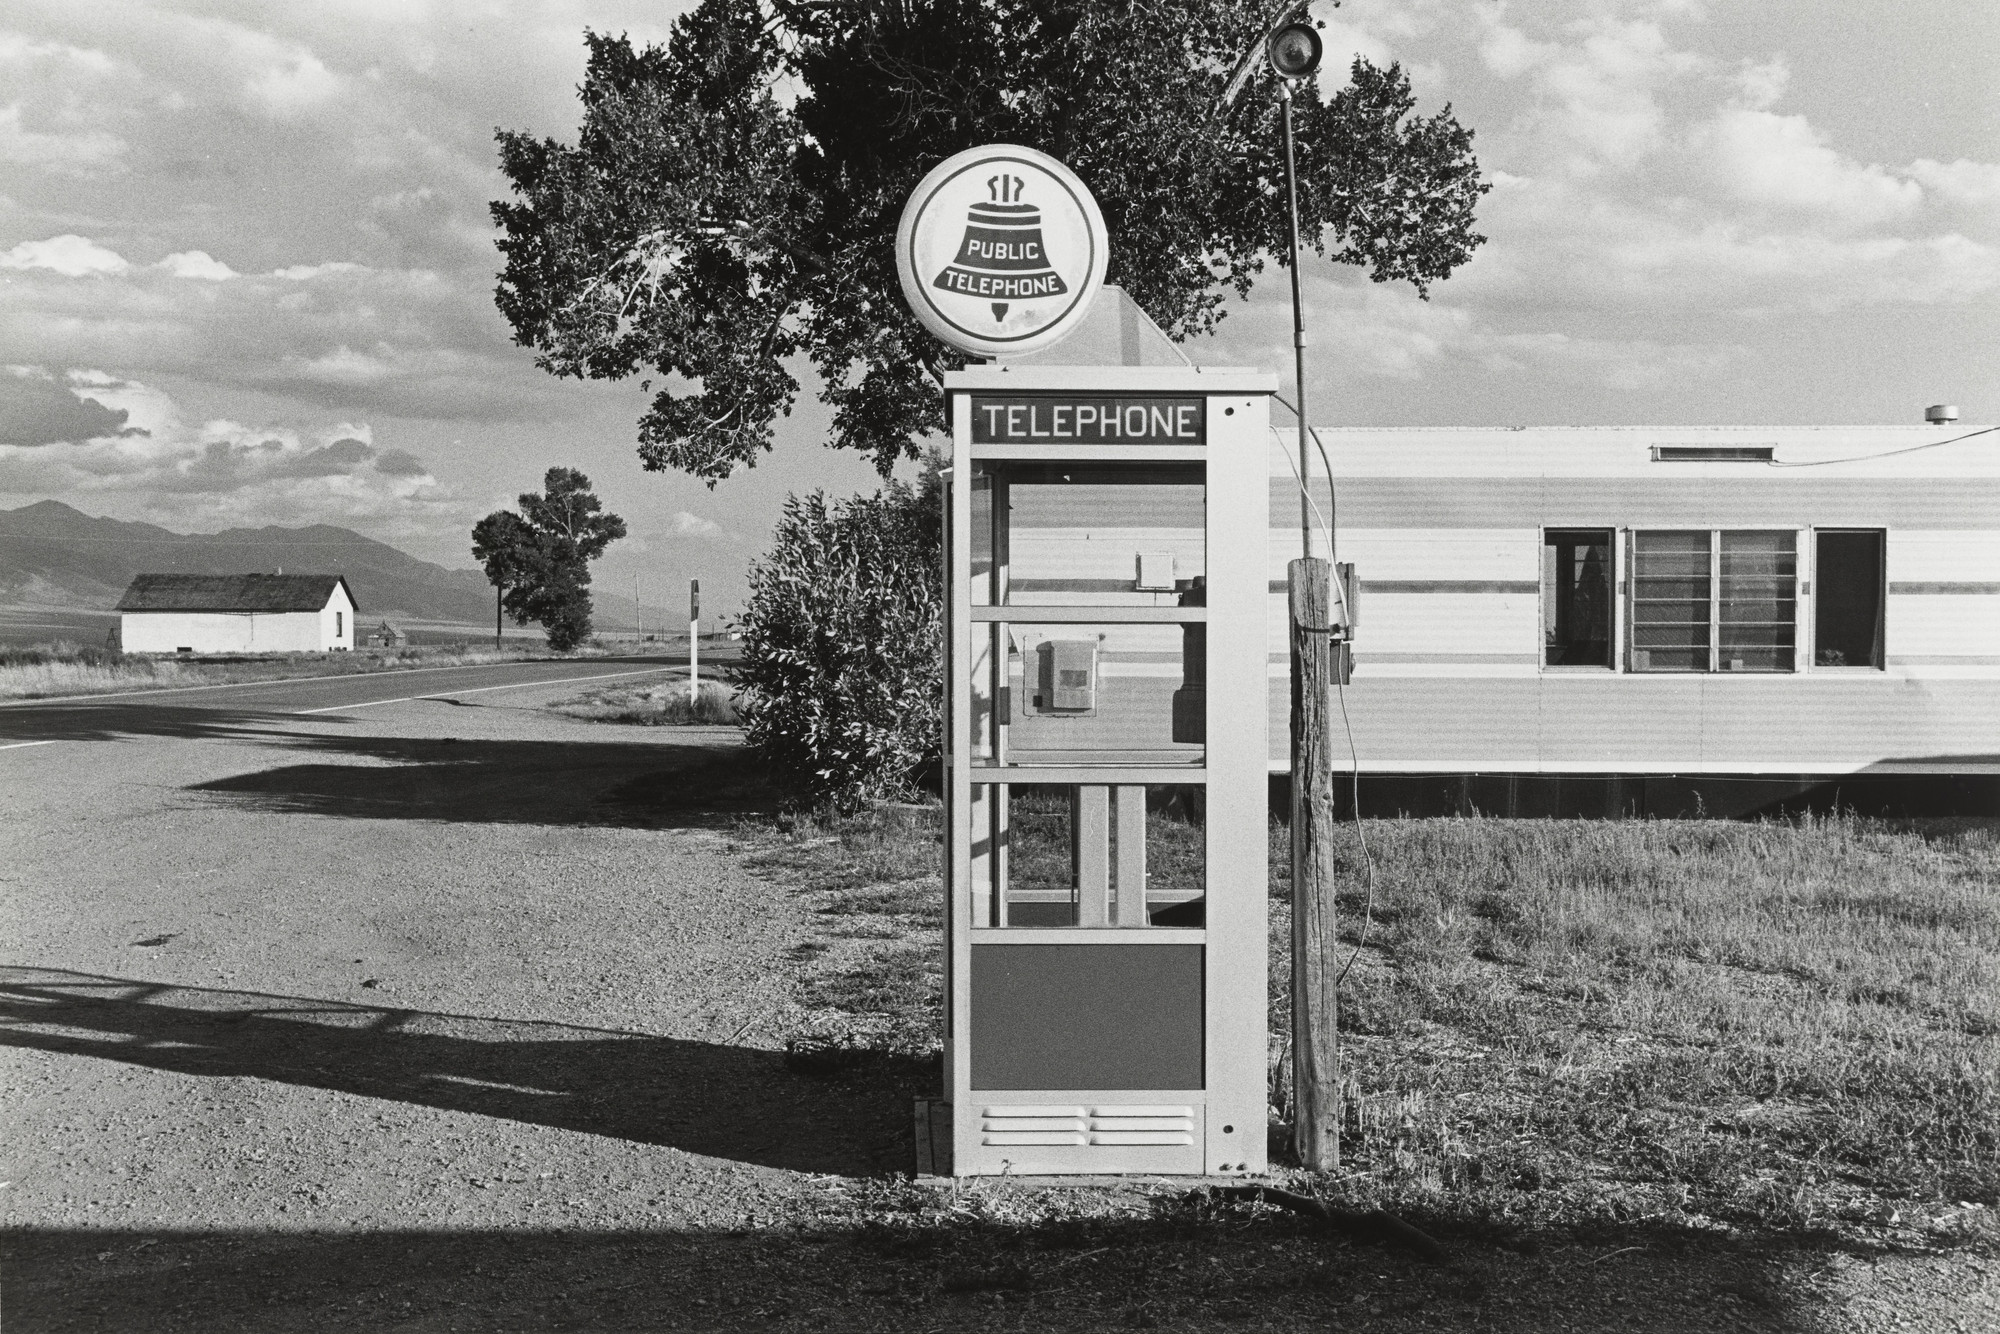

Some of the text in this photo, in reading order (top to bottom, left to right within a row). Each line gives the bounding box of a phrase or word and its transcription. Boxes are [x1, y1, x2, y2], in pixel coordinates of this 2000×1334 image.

[967, 239, 1039, 260] PUBLIC
[946, 270, 1060, 295] TELEPHONE
[981, 405, 1197, 437] TELEPHONE
